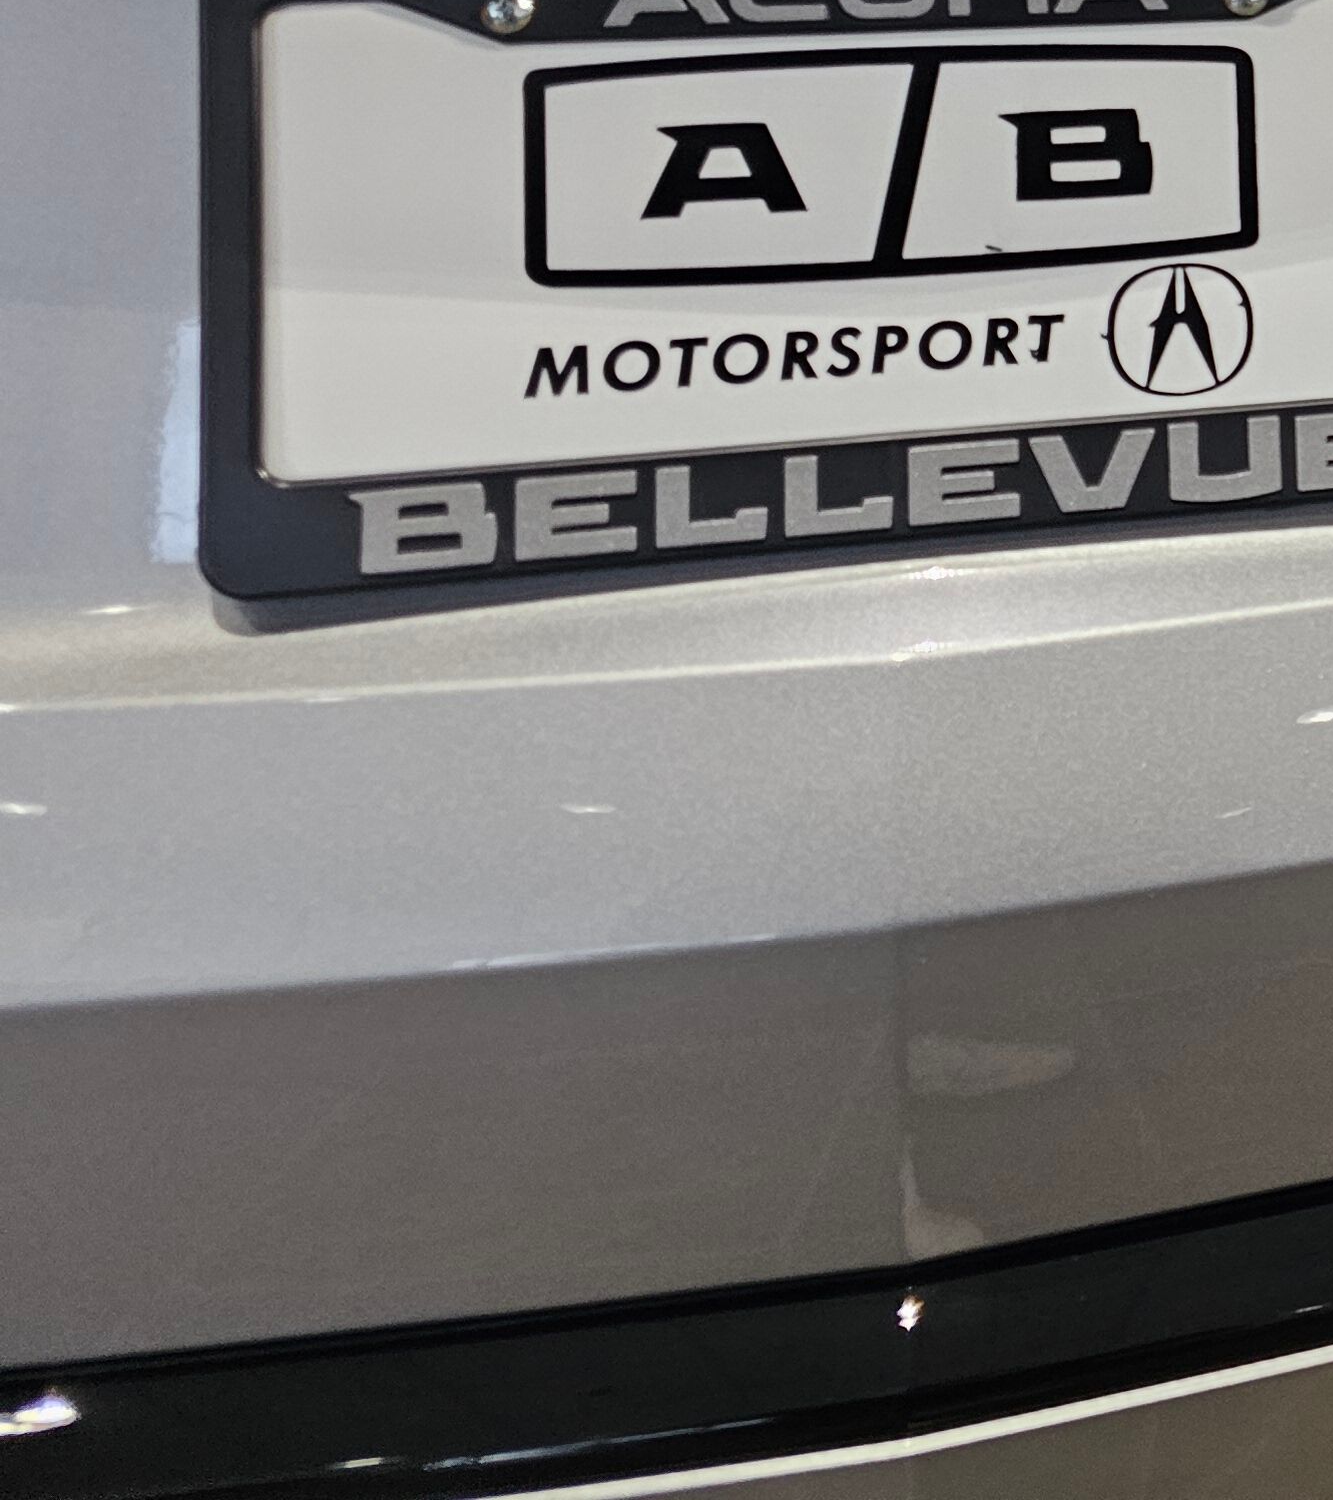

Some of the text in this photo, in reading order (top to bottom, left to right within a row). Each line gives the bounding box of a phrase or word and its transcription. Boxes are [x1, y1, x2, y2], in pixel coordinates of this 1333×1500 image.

[641, 108, 1153, 219] A B
[524, 314, 1066, 398] MOTORSPORT
